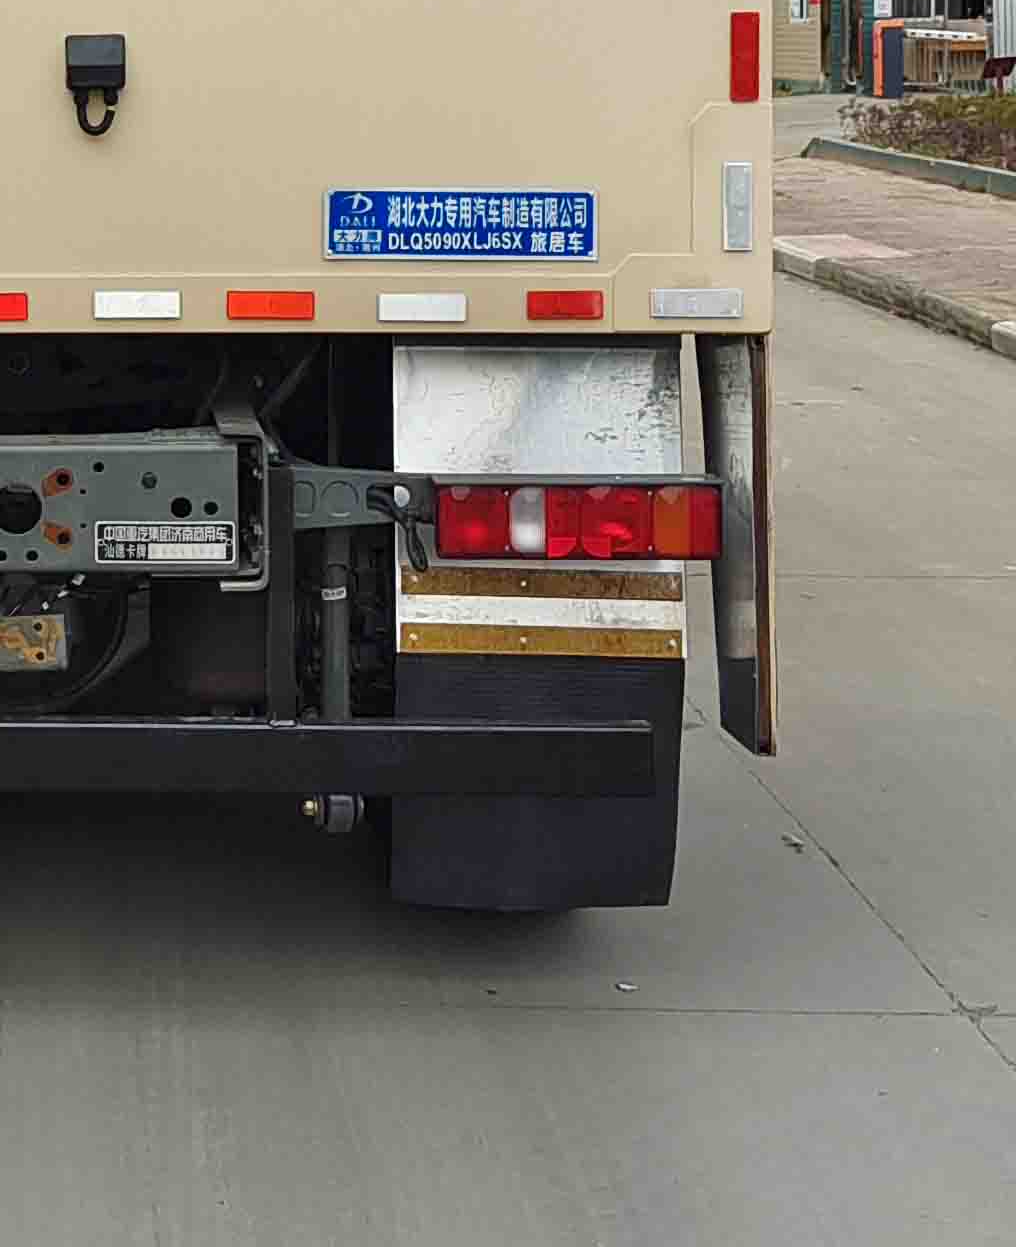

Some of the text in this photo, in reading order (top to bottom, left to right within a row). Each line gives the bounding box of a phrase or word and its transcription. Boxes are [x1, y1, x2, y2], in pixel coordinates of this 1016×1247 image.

[387, 196, 587, 228] 湖北大力专用汽车制造有限公司
[388, 232, 523, 251] DLQ5090XLJ6SX
[530, 232, 585, 253] 旅居车
